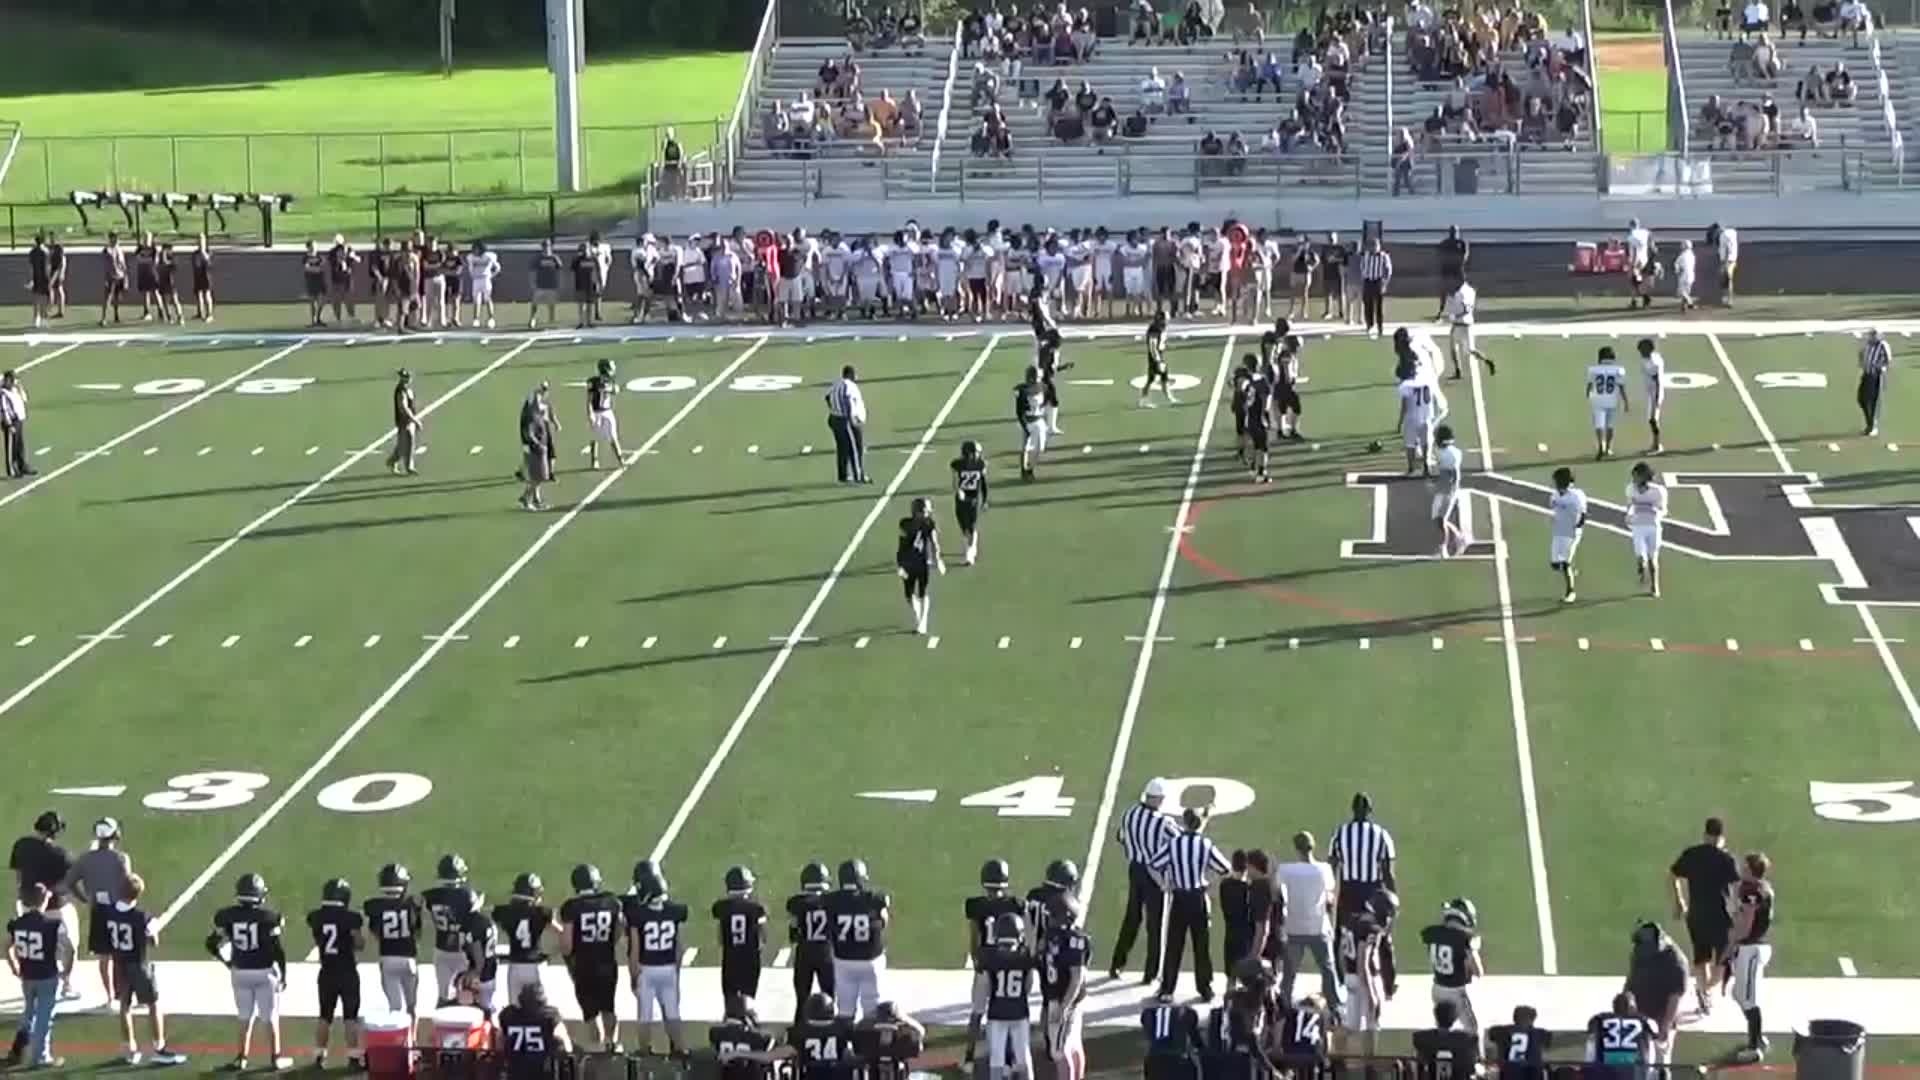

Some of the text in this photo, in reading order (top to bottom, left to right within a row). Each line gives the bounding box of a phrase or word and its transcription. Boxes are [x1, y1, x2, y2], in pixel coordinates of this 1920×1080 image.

[142, 771, 433, 812] 30
[106, 920, 133, 952] 33
[232, 922, 259, 950] 51
[322, 924, 338, 954] 2
[382, 911, 409, 938] 21
[516, 920, 531, 948] 4
[581, 912, 611, 942] 58
[644, 921, 675, 951] 22
[731, 914, 746, 944] 9
[807, 911, 827, 941] 12
[837, 914, 870, 942] 78
[14, 932, 43, 960] 52
[995, 970, 1023, 997] 16
[508, 1027, 544, 1051] 75
[1511, 1033, 1527, 1061] 2
[1602, 1018, 1642, 1049] 32
